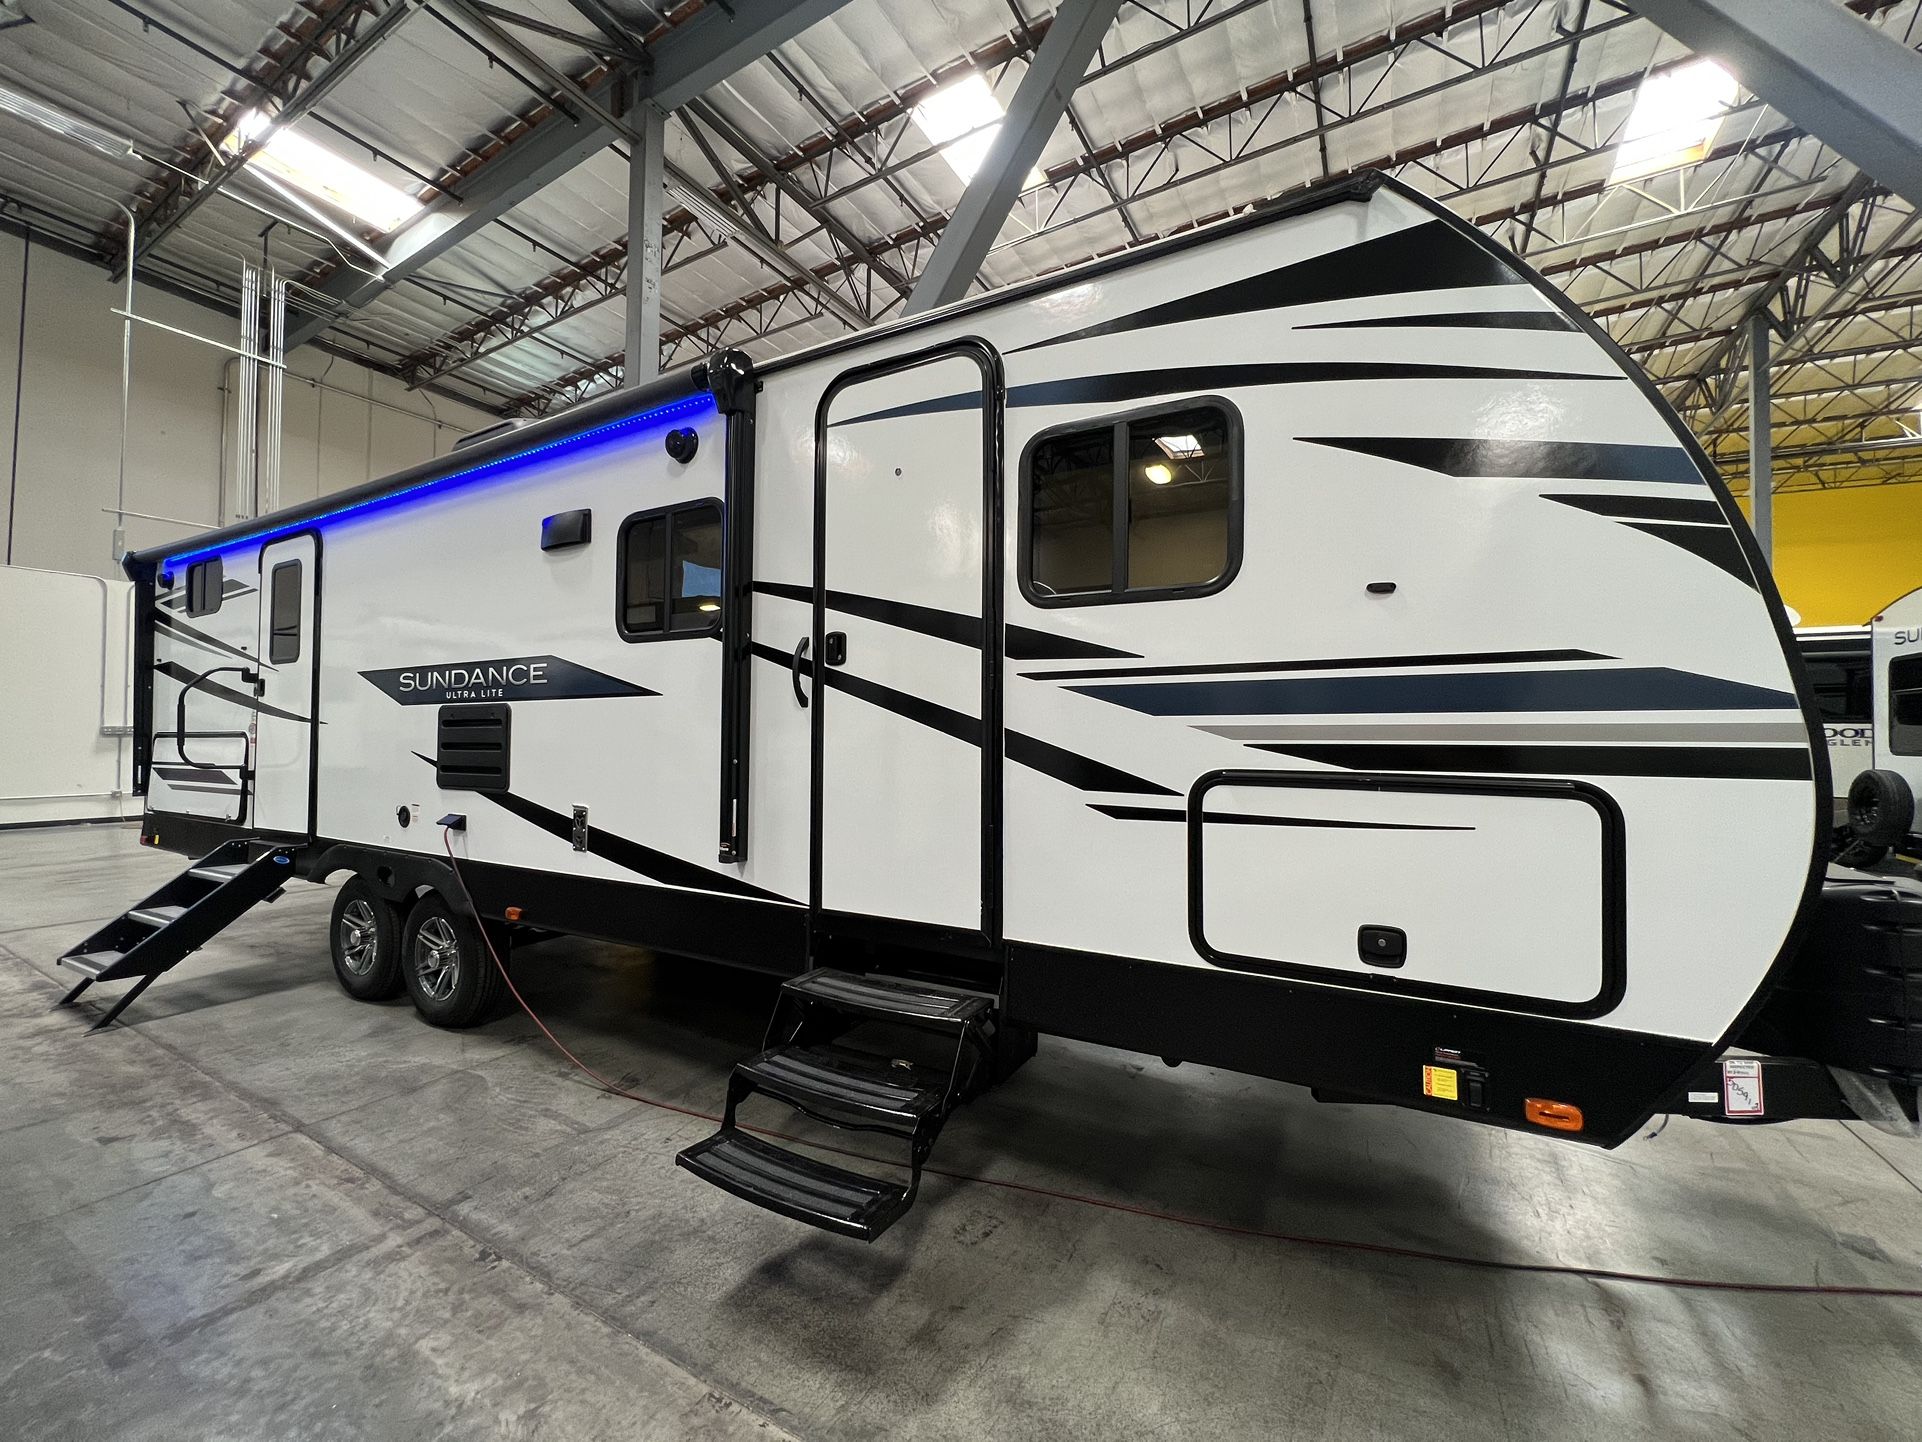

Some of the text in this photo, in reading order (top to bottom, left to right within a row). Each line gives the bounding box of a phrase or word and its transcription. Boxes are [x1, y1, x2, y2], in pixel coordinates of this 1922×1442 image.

[1894, 627, 1922, 645] SU
[399, 663, 548, 692] SUNDANCE
[446, 688, 503, 699] ULTRA LITE
